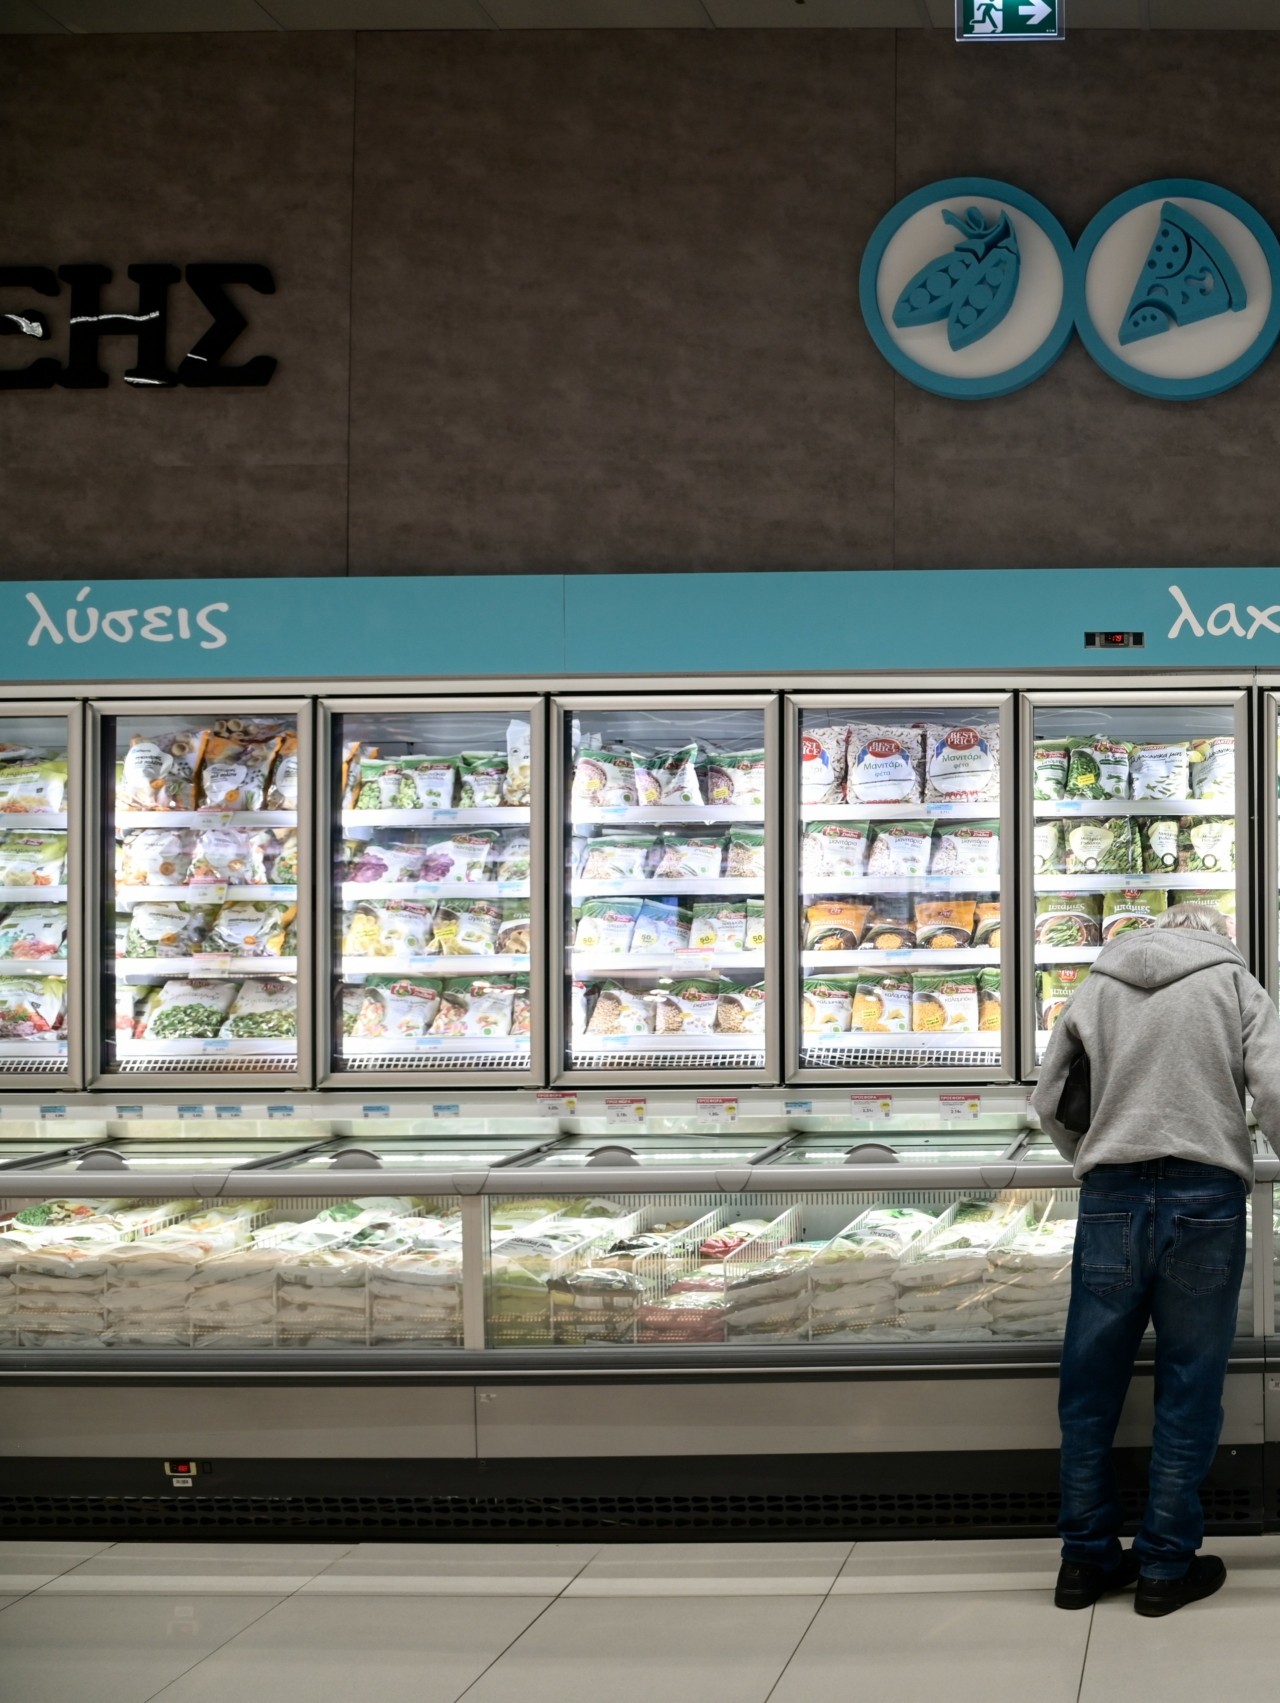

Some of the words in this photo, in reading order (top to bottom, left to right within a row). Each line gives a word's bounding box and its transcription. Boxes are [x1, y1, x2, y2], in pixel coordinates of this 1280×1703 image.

[26, 587, 229, 650] λύσεις
[950, 731, 974, 739] BEST
[947, 737, 977, 746] PRICE
[942, 754, 982, 764] Μανιτάρι
[863, 761, 903, 770] Μανιτάρι
[1114, 904, 1151, 913] μπάμιες
